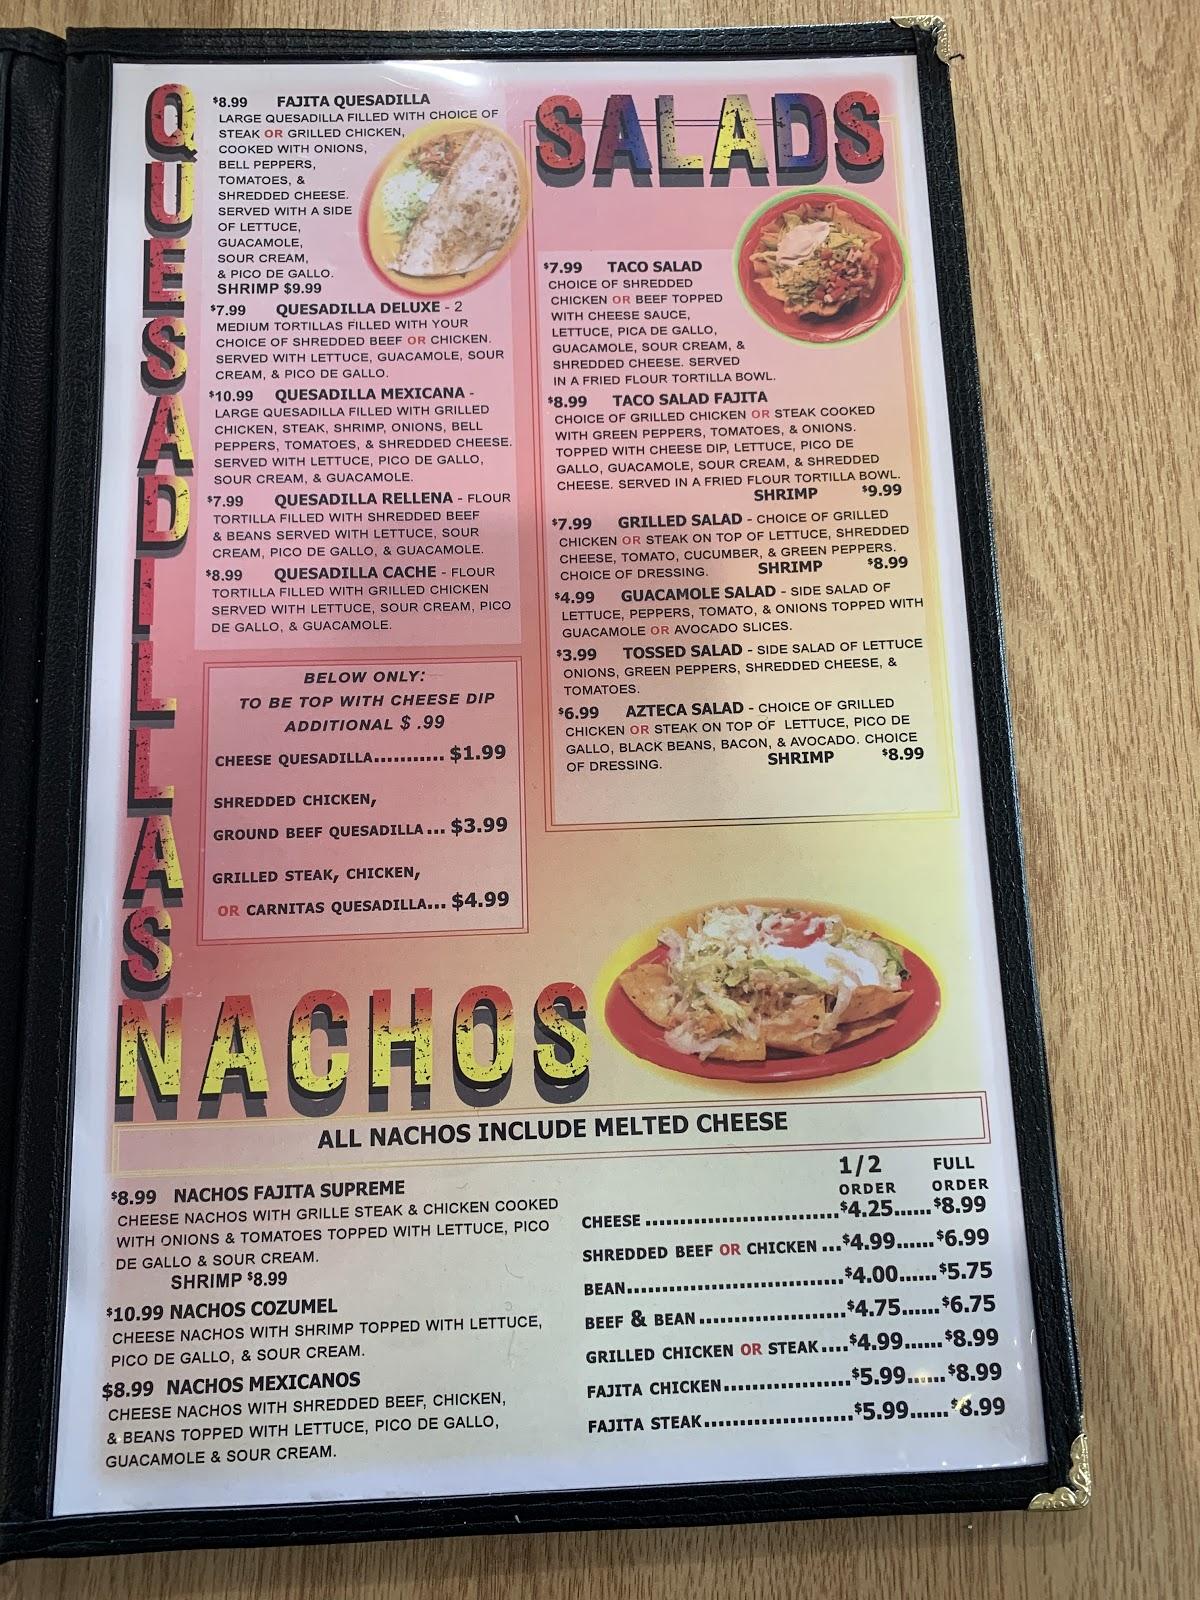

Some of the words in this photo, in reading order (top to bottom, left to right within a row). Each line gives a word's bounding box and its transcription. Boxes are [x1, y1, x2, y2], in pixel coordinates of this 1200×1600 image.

[213, 96, 248, 108] $8.99
[278, 96, 330, 107] FAJITA
[334, 94, 430, 109] QUESADILLA
[536, 91, 884, 181] SALADS
[218, 238, 302, 248] GUACAMOLE,
[218, 254, 254, 263] SOUR
[259, 254, 308, 264] CREAM,
[544, 262, 582, 274] $7.99
[607, 261, 648, 272] TACO
[653, 261, 702, 272] SALAD
[218, 283, 279, 294] SHRIMP
[284, 282, 321, 295] $9.99
[549, 280, 597, 289] CHOICE
[602, 280, 618, 288] OF
[623, 279, 693, 288] SHREDDED
[210, 304, 246, 316] $7.99
[276, 303, 376, 318] QUESADILLA
[381, 301, 440, 313] DELUXE
[454, 300, 462, 312] 2
[209, 390, 253, 402] $10.99
[275, 388, 376, 404] QUESADILLA
[381, 387, 465, 400] MEXICANA
[548, 396, 587, 408] $8.99
[612, 394, 654, 406] TACO
[659, 393, 709, 405] SALAD
[714, 391, 768, 404] FAJITA
[214, 475, 251, 484] SOUR
[256, 474, 307, 484] CREAM,
[313, 474, 322, 483] &
[326, 472, 413, 482] GUACAMOLE.
[207, 495, 243, 507] $7.99
[275, 493, 377, 509] QUESADILLA
[382, 492, 453, 504] RELLENA
[468, 493, 511, 503] FLOUR
[754, 488, 818, 501] SHRIMP
[862, 484, 902, 497] $9.99
[552, 518, 592, 530] $7.99
[618, 515, 686, 528] GRILLED
[692, 513, 742, 526] SALAD
[757, 513, 807, 524] CHOICE
[811, 512, 828, 522] OF
[834, 510, 888, 521] GRILLED
[120, 83, 197, 997] QUESADILLAS
[758, 560, 822, 574] SHRIMP
[868, 556, 908, 569] $8.99
[206, 569, 242, 581] $8.99
[274, 566, 378, 583] QUESADILLA
[383, 566, 436, 578] CACHE
[451, 567, 495, 577] FLOUR
[555, 591, 594, 604] $4.99
[621, 587, 720, 602] GUACAMOLE
[725, 585, 776, 598] SALAD
[791, 586, 821, 596] SIDE
[826, 584, 868, 594] SALAD
[873, 582, 890, 592] OF
[561, 626, 646, 639] GUACAMOLE
[651, 626, 670, 635] OR
[674, 623, 738, 634] AVOCADO
[743, 621, 792, 632] SLICES.
[556, 648, 596, 661] $3.99
[623, 646, 686, 659] TOSSED
[691, 644, 742, 657] SALAD
[758, 644, 788, 655] SIDE
[792, 643, 834, 653] SALAD
[840, 642, 857, 652] OF
[863, 638, 923, 650] LETTUCE
[304, 672, 367, 684] BELOW
[374, 671, 425, 682] ONLY:
[564, 684, 640, 696] TOMATOES.
[240, 698, 261, 709] TO
[268, 697, 292, 708] BE
[300, 696, 333, 708] TOP
[340, 695, 384, 707] WITH
[391, 693, 460, 706] CHEESE
[466, 693, 494, 704] DIP
[558, 706, 599, 720] $6.99
[626, 704, 688, 718] AZTECA
[692, 702, 744, 716] SALAD
[759, 702, 810, 713] CHOICE
[814, 701, 832, 711] OF
[838, 698, 894, 710] GRILLED
[284, 719, 393, 732] ADDITIONAL
[215, 754, 271, 766] CHEESE
[450, 744, 506, 762] $1.99
[768, 751, 834, 765] SHRIMP
[882, 747, 924, 760] $8.99
[214, 796, 296, 808] SHREDDED
[303, 794, 376, 808] CHICKEN,
[213, 828, 279, 841] GROUND
[286, 827, 322, 838] BEEF
[451, 817, 507, 837] $3.99
[212, 871, 278, 884] GRILLED
[285, 869, 339, 884] STEAK,
[346, 866, 420, 880] CHICKEN,
[218, 906, 240, 916] OR
[247, 902, 325, 917] CARNITAS
[452, 891, 509, 912] $4.99
[115, 982, 592, 1110] NACHOS
[318, 1129, 362, 1149] ALL
[370, 1124, 471, 1146] NACHOS
[479, 1119, 586, 1142] INCLUDE
[595, 1115, 688, 1137] MELTED
[697, 1112, 788, 1133] CHEESE
[840, 1155, 882, 1177] 1/2
[934, 1156, 974, 1170] FULL
[111, 1190, 156, 1206] $8.99
[174, 1186, 248, 1203] NACHOS
[254, 1184, 315, 1200] FAJITA
[320, 1180, 404, 1198] SUPREME
[839, 1182, 896, 1195] ORDER
[932, 1178, 989, 1191] ORDER
[583, 1246, 668, 1262] SHREDDED
[676, 1244, 713, 1258] BEEF
[720, 1244, 741, 1256] OR
[171, 1273, 242, 1290] SHRIMP
[248, 1271, 287, 1286] $8.99
[106, 1305, 164, 1322] $10.99
[170, 1302, 245, 1319] NACHOS
[251, 1298, 338, 1316] COZUMEL
[586, 1316, 623, 1330] BEEF
[631, 1310, 647, 1327] &
[586, 1348, 655, 1364] GRILLED
[662, 1344, 734, 1360] CHICKEN
[740, 1343, 762, 1356] OR
[102, 1380, 154, 1402] $8.99
[167, 1377, 243, 1395] NACHOS
[250, 1371, 360, 1392] MEXICANOS
[588, 1383, 642, 1398] FAJITA
[588, 1418, 644, 1433] FAJITA
